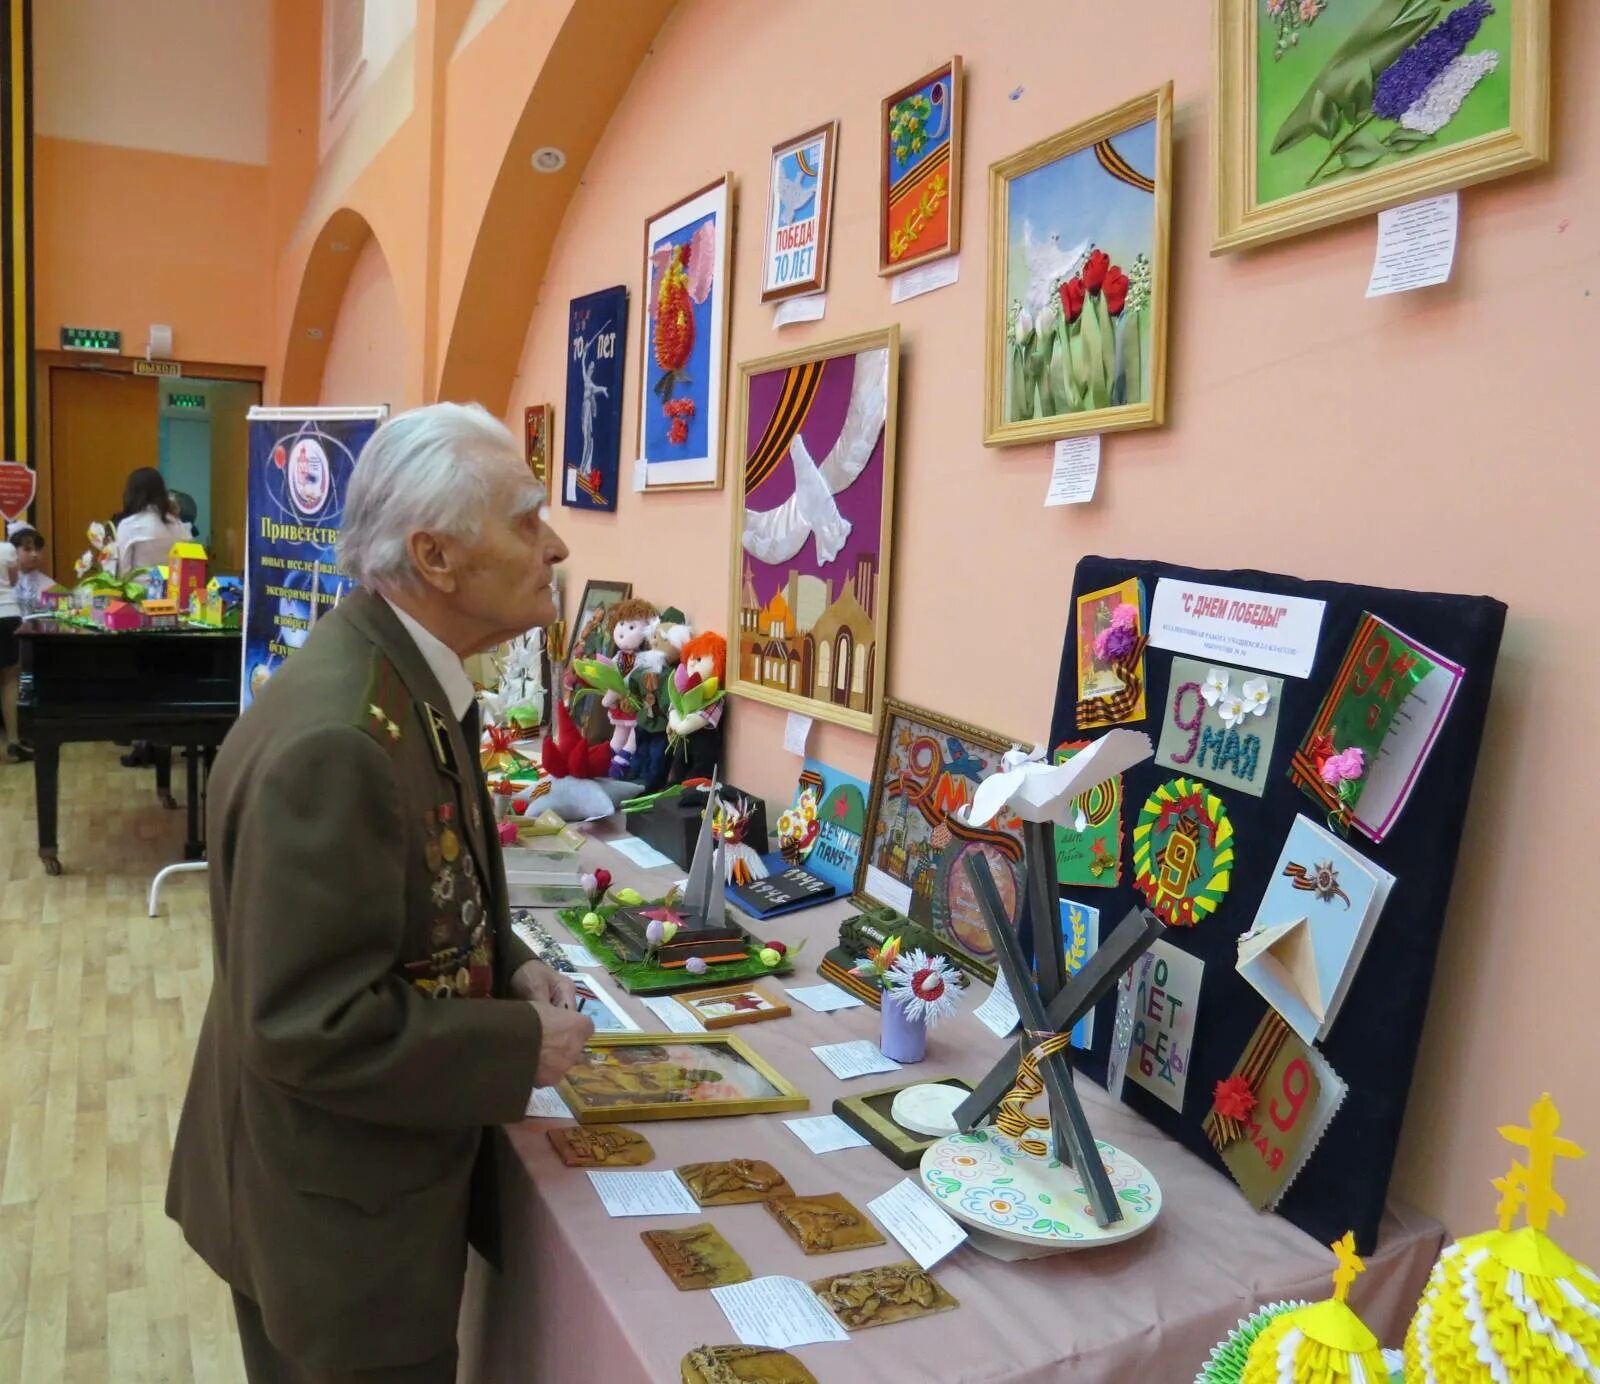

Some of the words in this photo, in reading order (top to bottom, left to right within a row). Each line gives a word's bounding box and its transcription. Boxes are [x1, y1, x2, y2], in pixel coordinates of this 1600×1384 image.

[776, 221, 815, 252] ПОБЕДА!
[775, 253, 790, 284] 70
[790, 246, 814, 280] ЛЕТ
[261, 516, 338, 544] Приветств
[1192, 595, 1228, 619] ДНЕМ
[1352, 636, 1391, 696] 9
[1170, 682, 1205, 764] 9
[1197, 725, 1261, 782] МАЯ
[816, 840, 856, 873] ПАМЯТ
[1158, 830, 1197, 900] 9
[1269, 1057, 1312, 1133] 9
